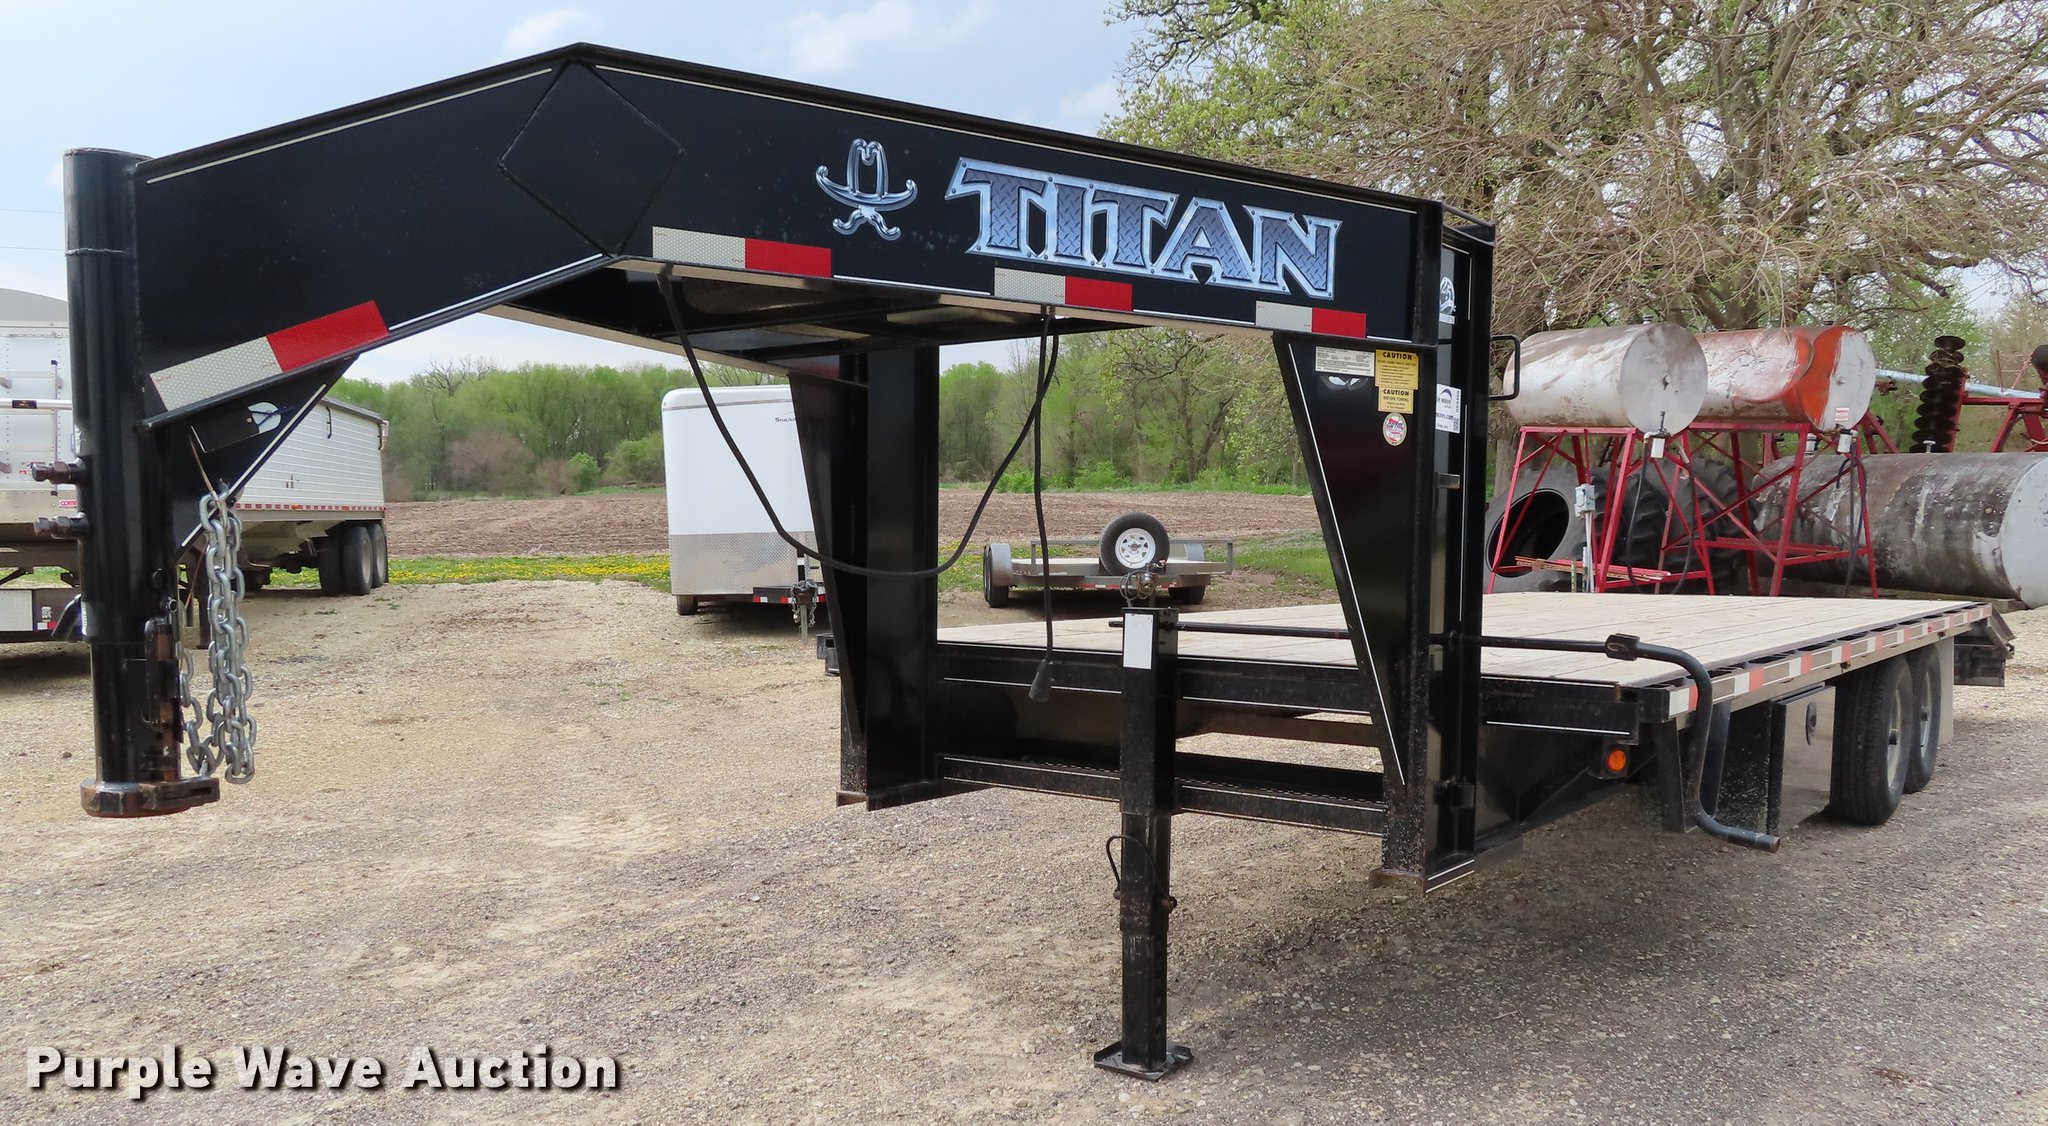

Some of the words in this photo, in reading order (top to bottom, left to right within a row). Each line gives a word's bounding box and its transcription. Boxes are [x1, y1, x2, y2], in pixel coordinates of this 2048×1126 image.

[945, 157, 1343, 300] TITAN
[1382, 351, 1413, 361] CAUTION
[1383, 388, 1410, 397] CAUTION
